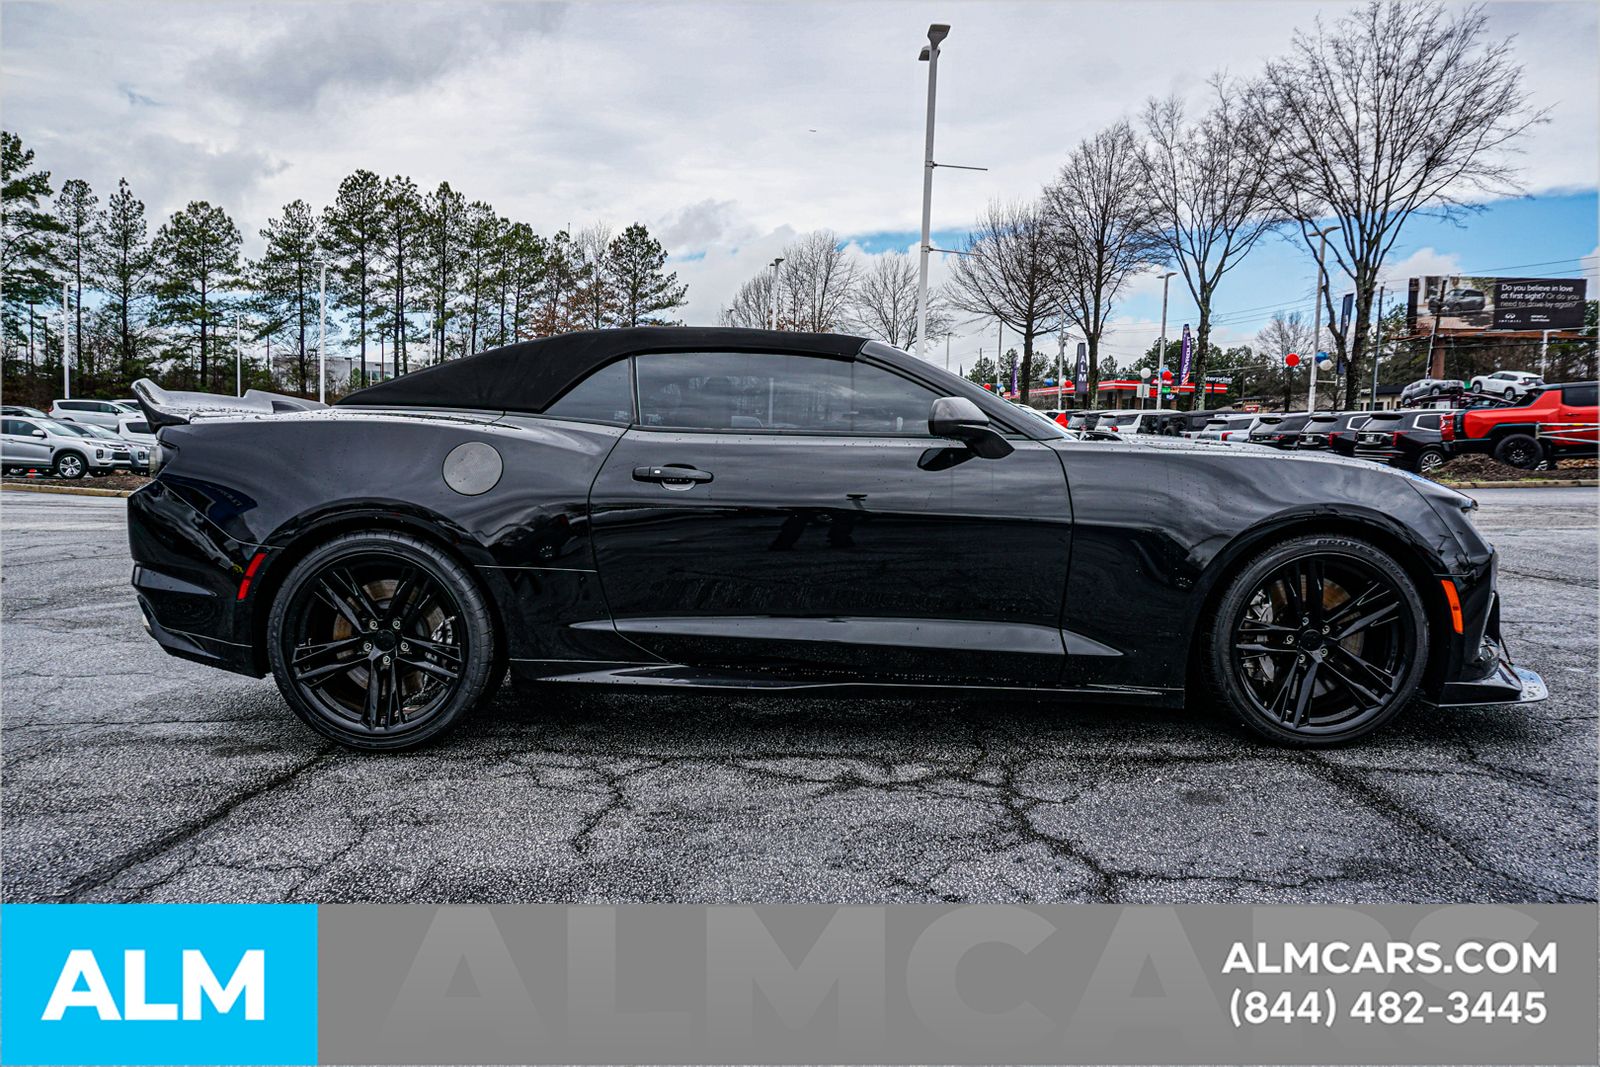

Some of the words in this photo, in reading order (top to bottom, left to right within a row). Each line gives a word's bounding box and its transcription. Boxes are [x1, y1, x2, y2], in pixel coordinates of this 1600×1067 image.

[1527, 284, 1550, 292] believe
[1524, 293, 1546, 301] sight?
[1078, 355, 1087, 382] ALM
